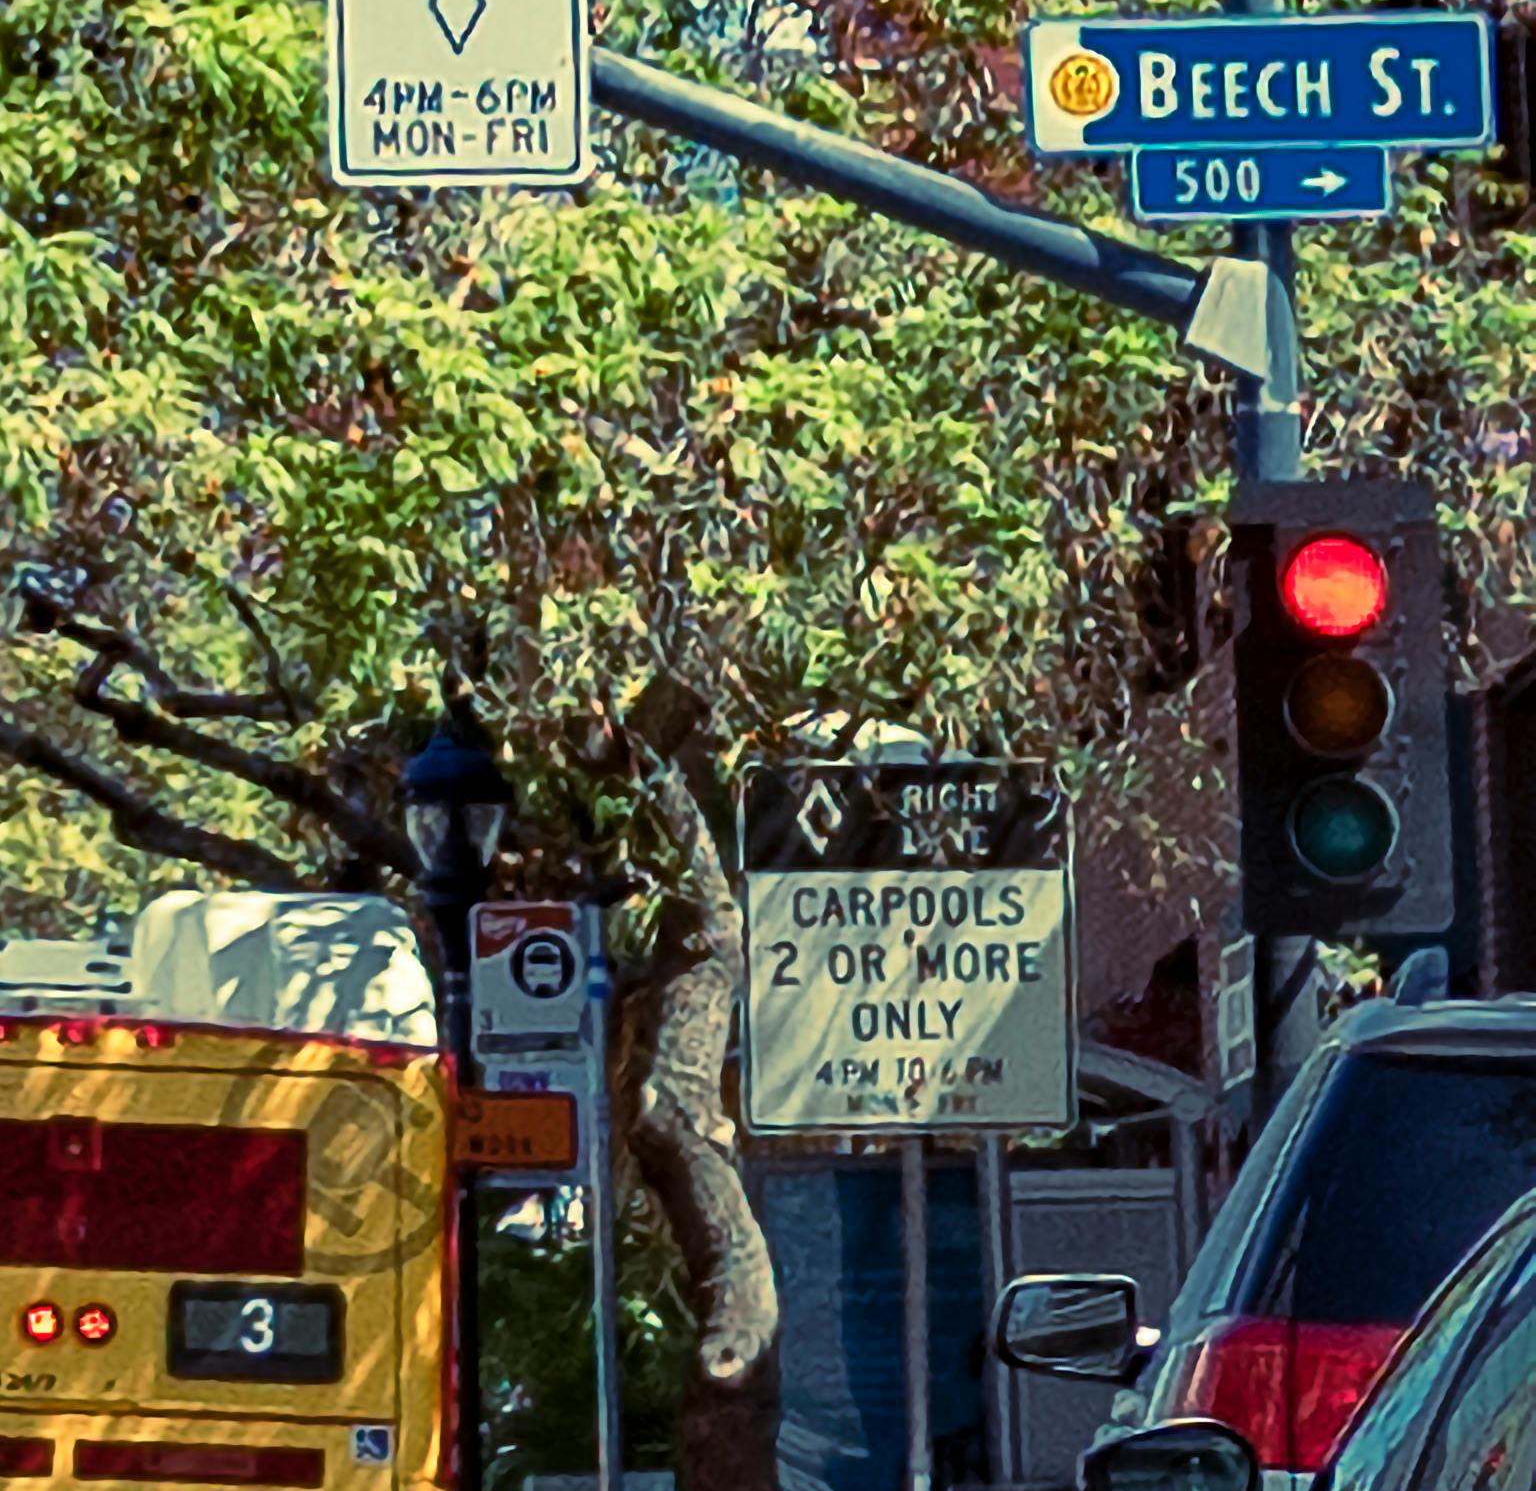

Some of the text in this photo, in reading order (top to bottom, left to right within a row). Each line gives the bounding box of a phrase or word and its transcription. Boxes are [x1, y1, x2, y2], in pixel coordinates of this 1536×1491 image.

[1138, 50, 1333, 119] BEECH
[373, 118, 549, 156] MON-FRI
[1174, 157, 1261, 203] 500
[792, 885, 1025, 928] CARPOOLS
[765, 939, 1042, 986] 2 OR MORE
[851, 998, 964, 1043] ONLY
[842, 1055, 879, 1085] PM
[239, 1297, 275, 1353] 3
